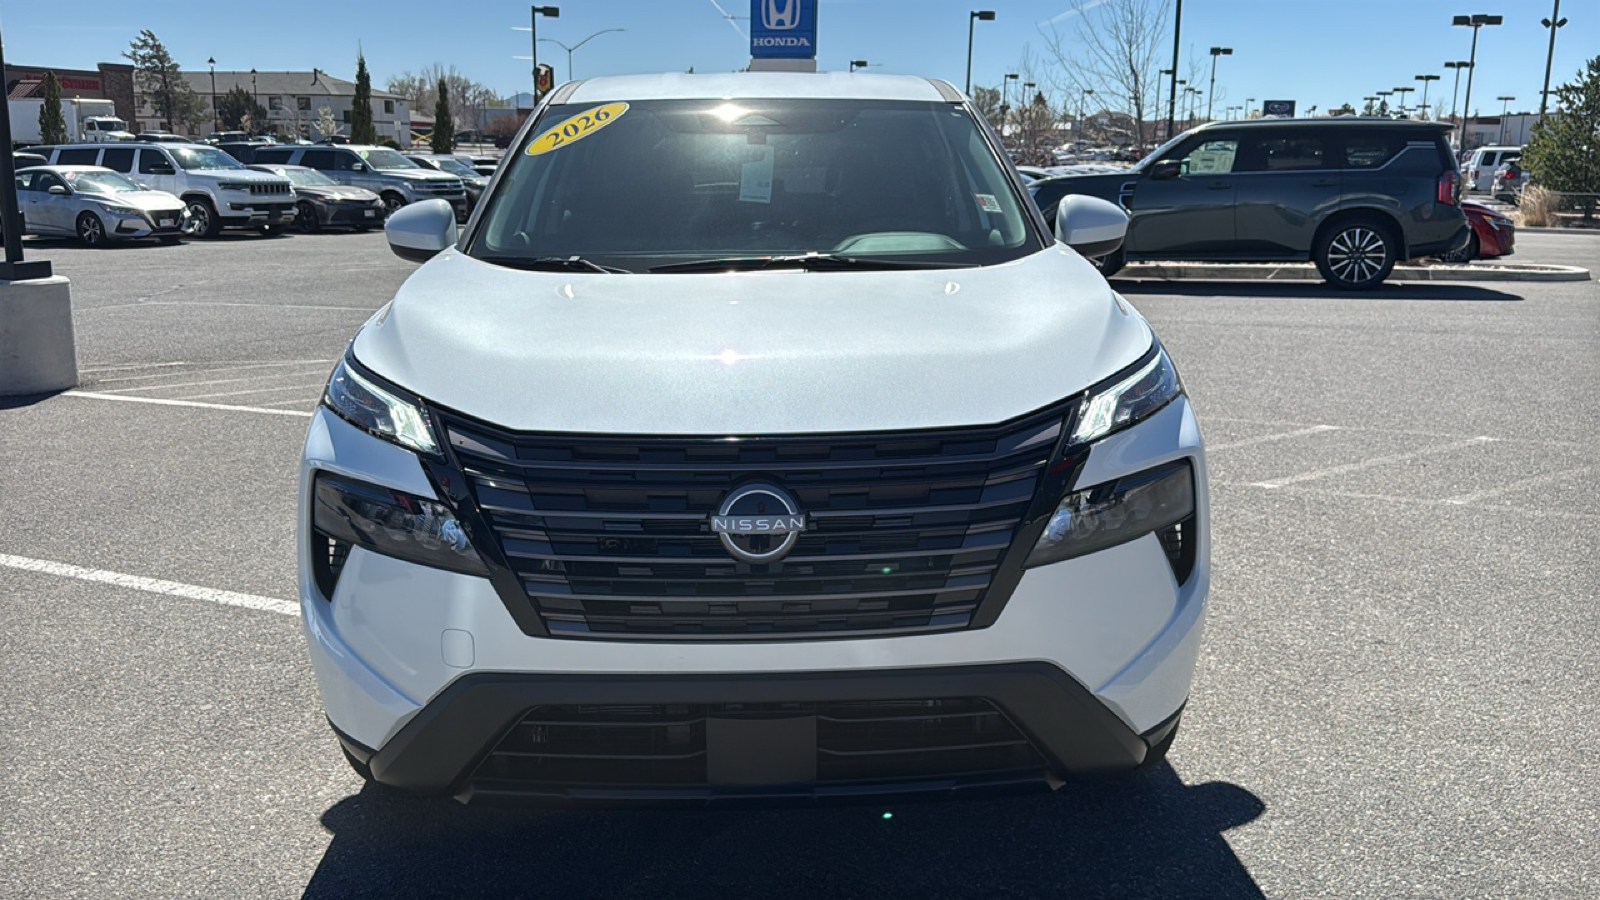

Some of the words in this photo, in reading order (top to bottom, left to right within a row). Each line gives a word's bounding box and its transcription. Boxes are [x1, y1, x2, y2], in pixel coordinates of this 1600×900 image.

[753, 37, 810, 46] HONDA
[546, 107, 610, 147] 2026
[714, 518, 803, 531] NISSAN
